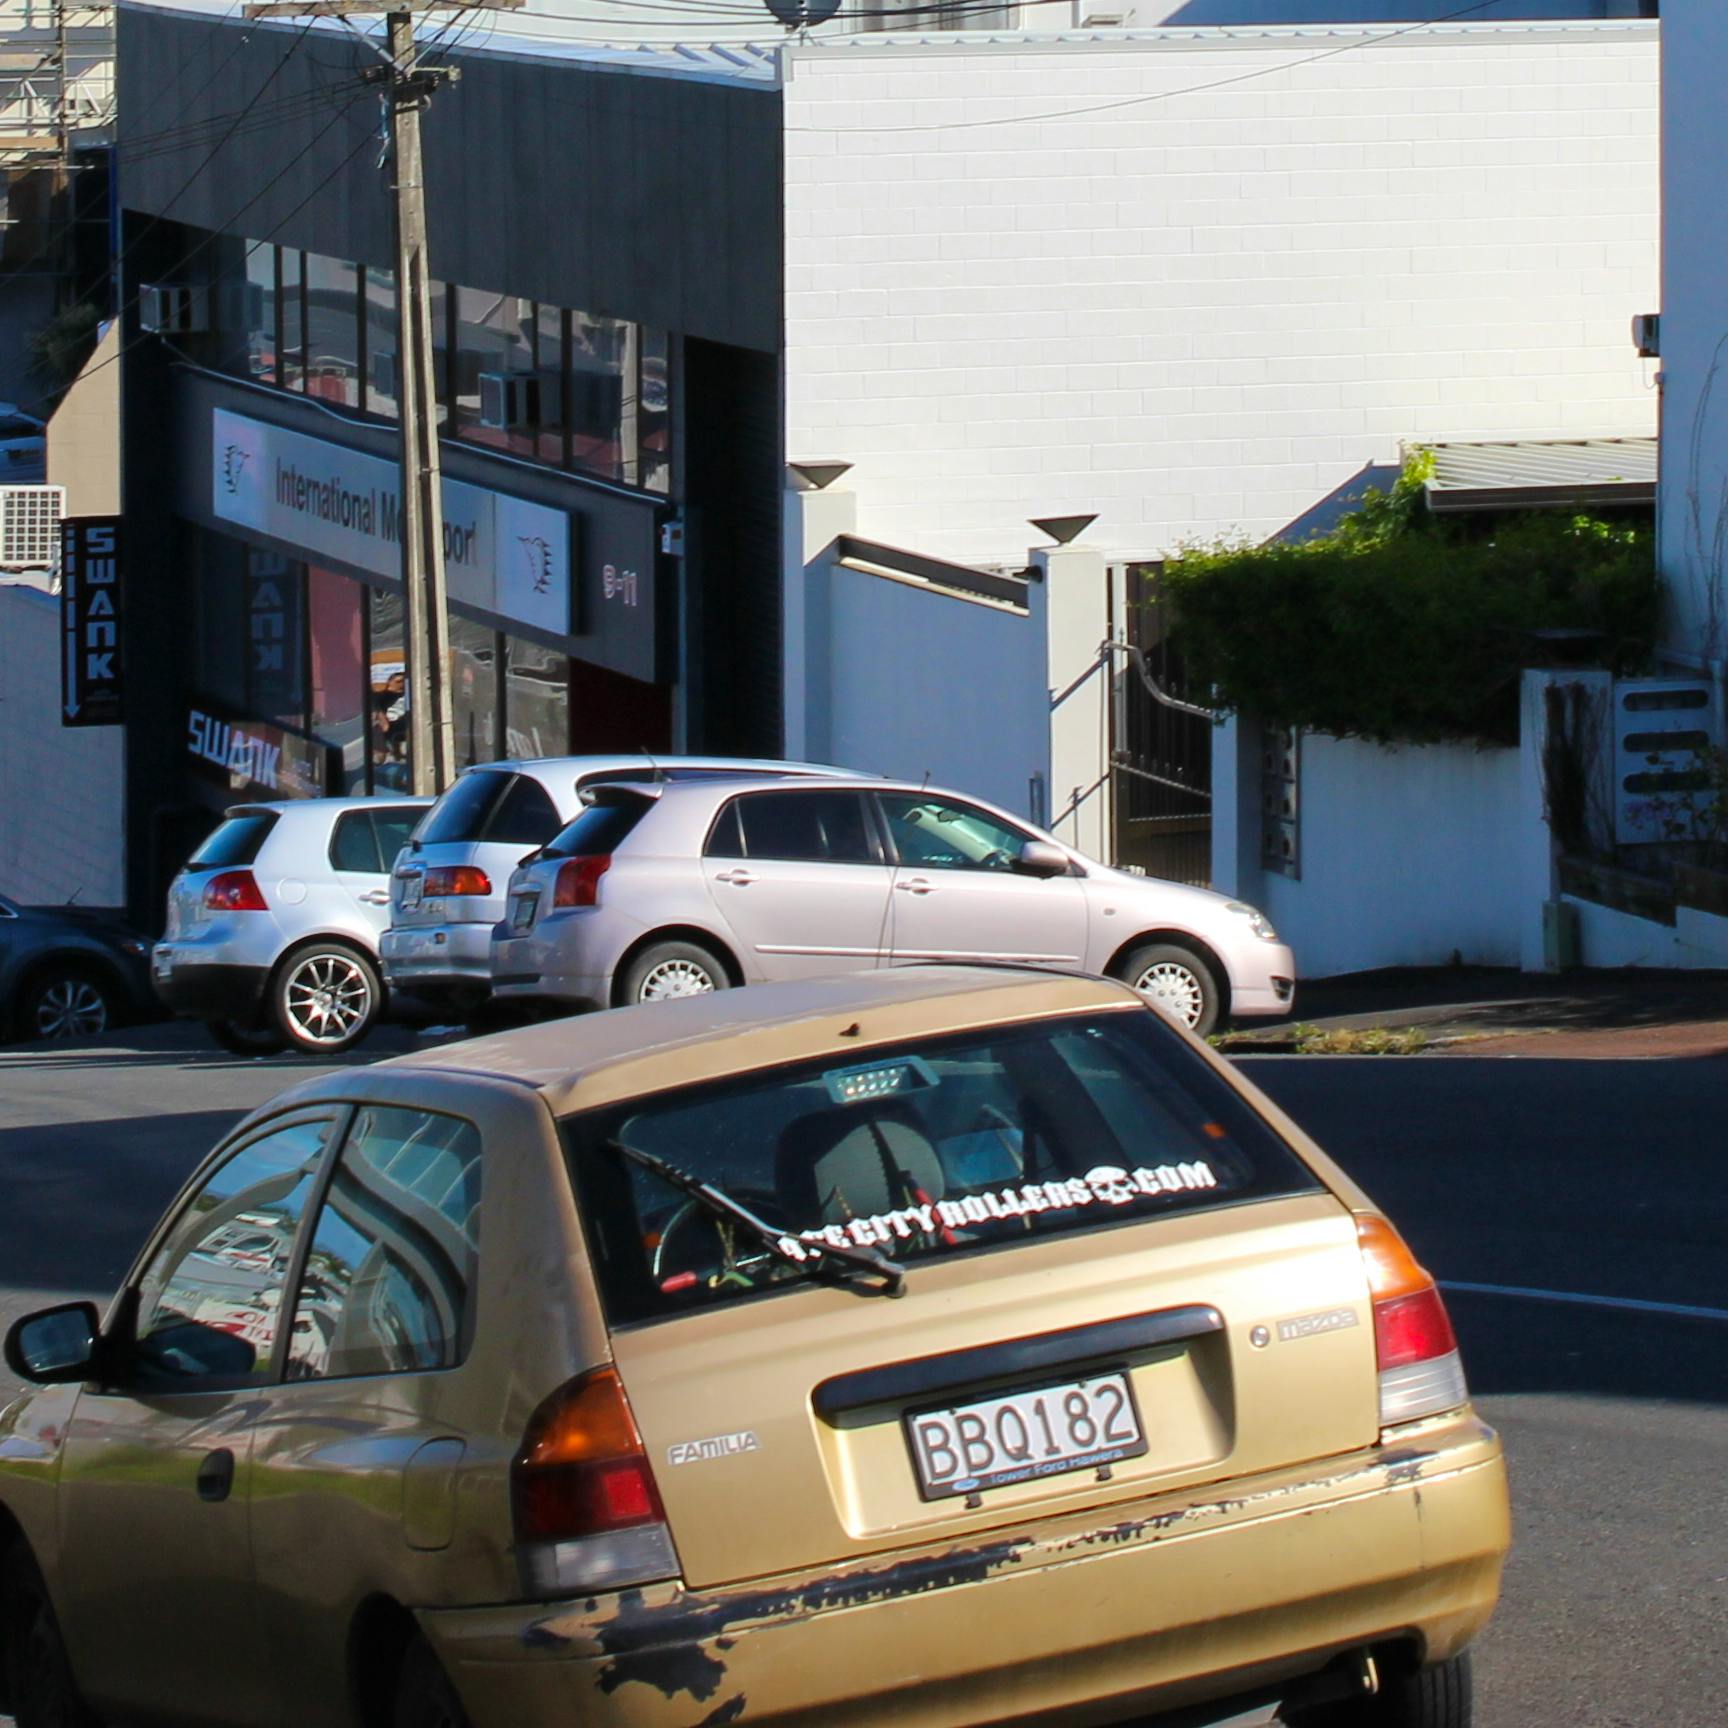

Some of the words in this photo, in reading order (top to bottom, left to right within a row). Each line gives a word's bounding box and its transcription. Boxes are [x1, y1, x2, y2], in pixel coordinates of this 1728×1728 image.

[275, 456, 377, 537] International
[86, 527, 116, 680] SWANK
[188, 710, 281, 790] SWANK
[670, 1432, 759, 1465] FAMILIA
[918, 1383, 1134, 1481] BBQ182
